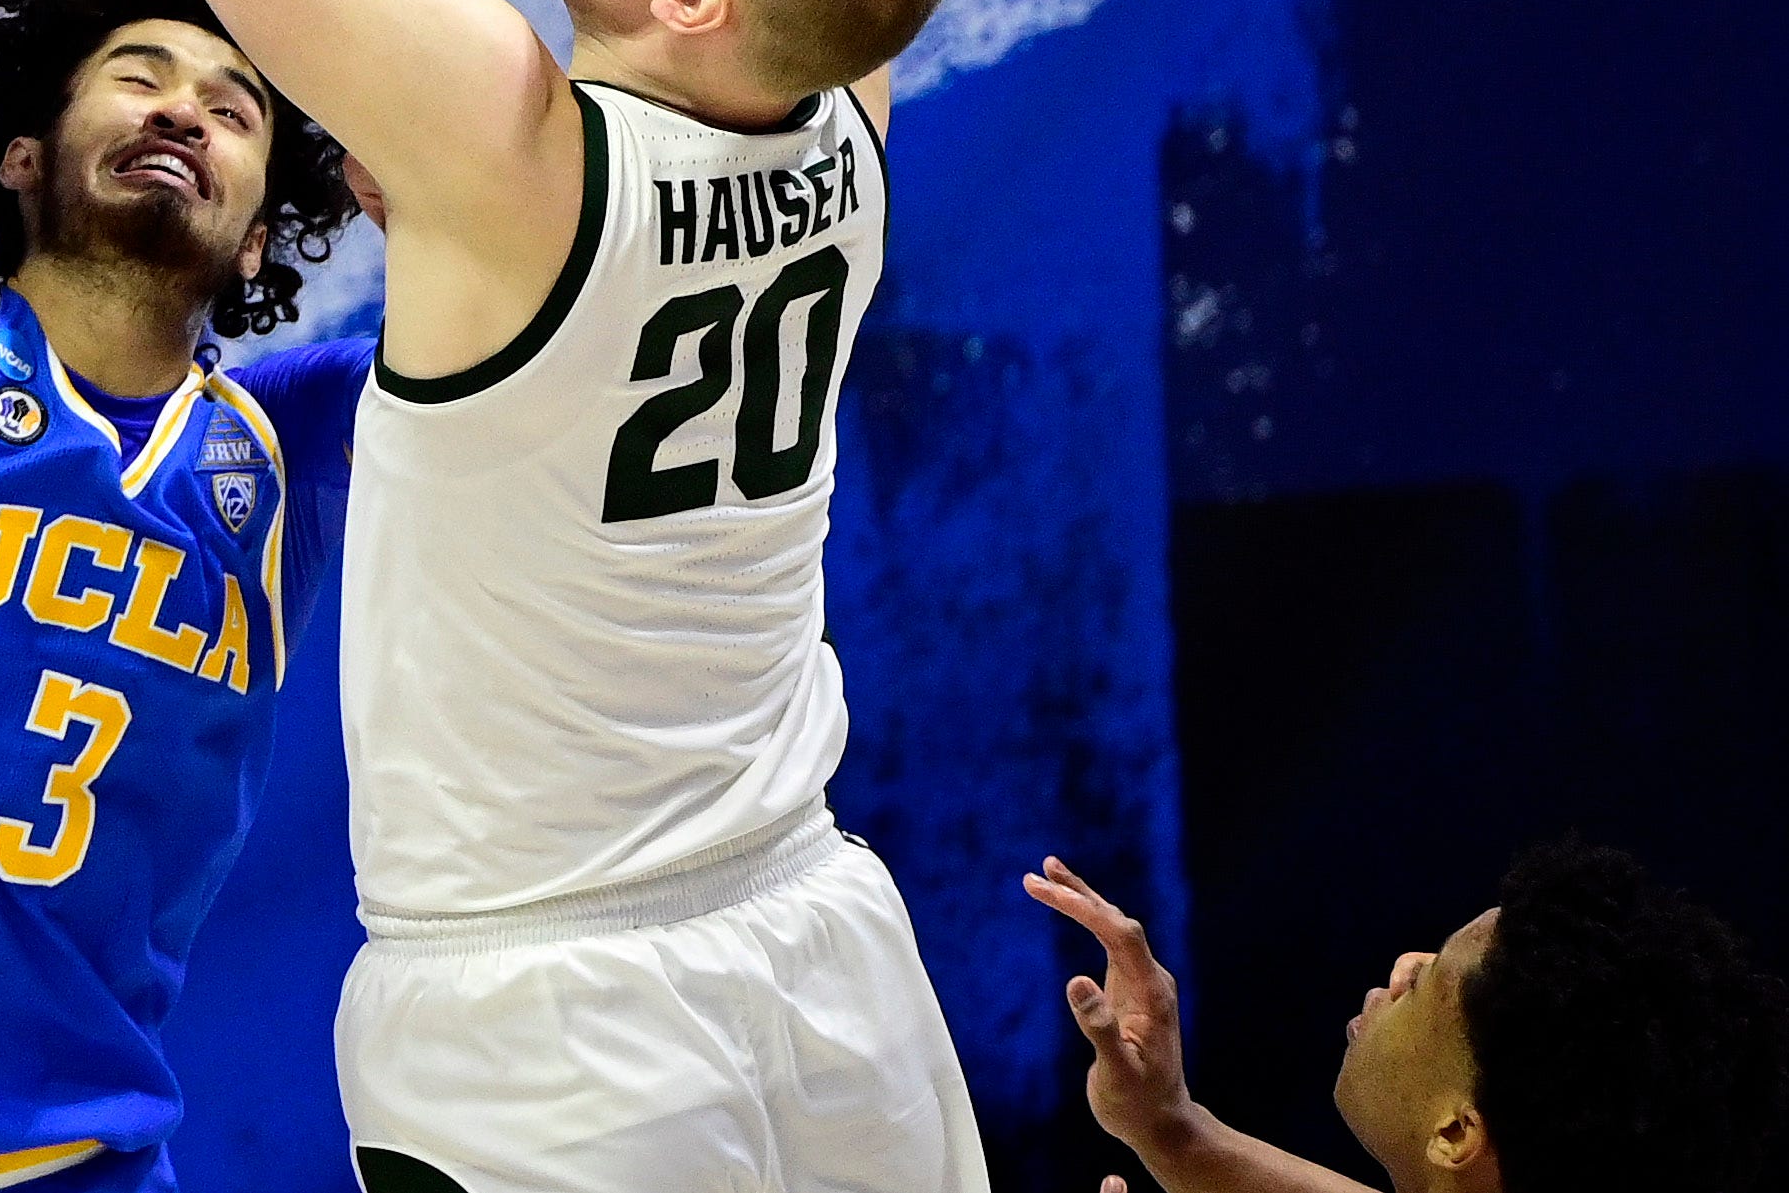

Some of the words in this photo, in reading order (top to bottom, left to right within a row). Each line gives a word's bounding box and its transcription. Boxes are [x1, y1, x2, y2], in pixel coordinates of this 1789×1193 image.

[653, 137, 860, 266] HAUSER
[601, 244, 850, 524] 20
[204, 440, 253, 463] JRW
